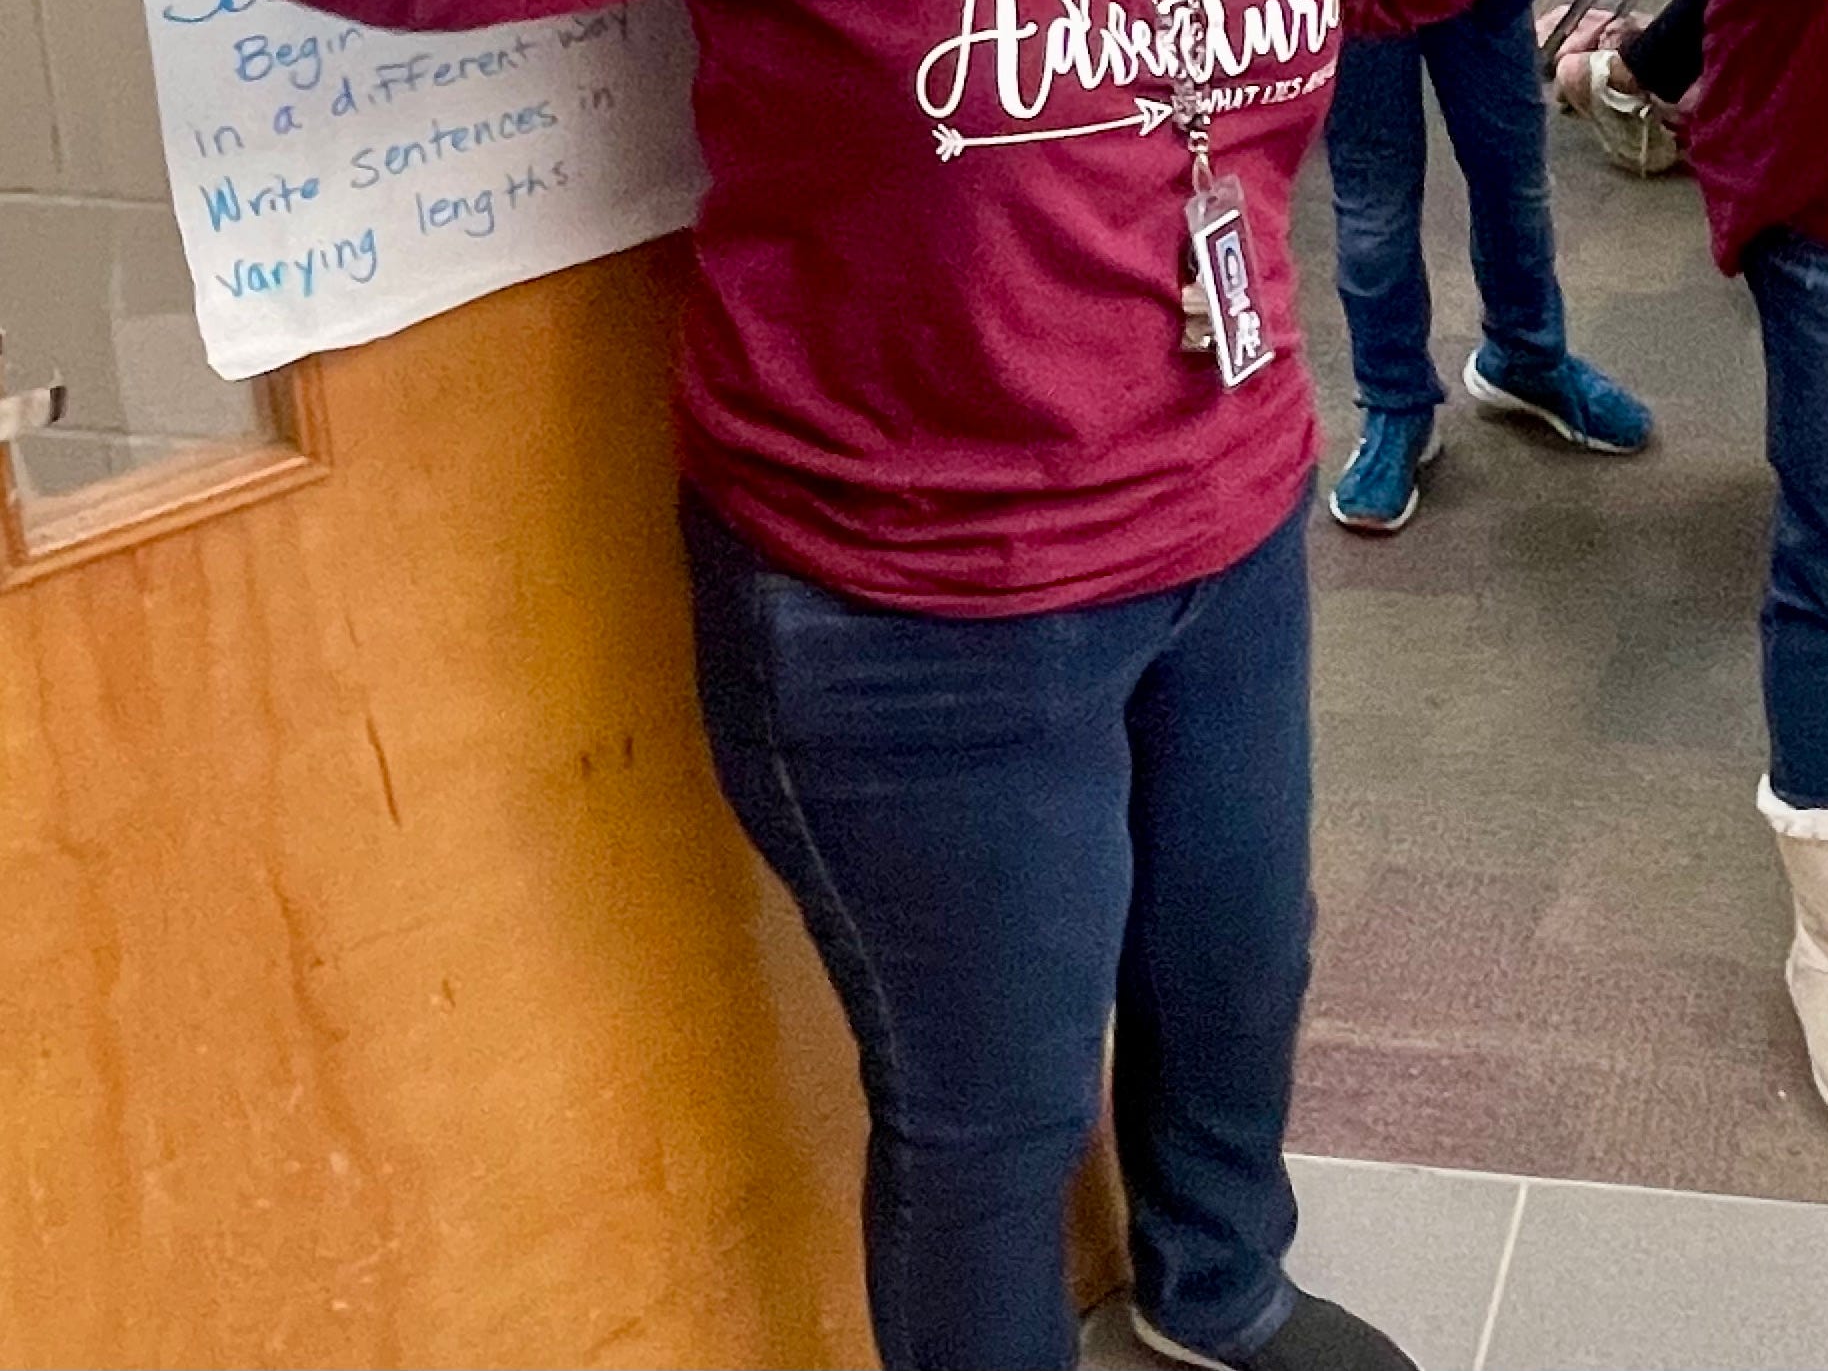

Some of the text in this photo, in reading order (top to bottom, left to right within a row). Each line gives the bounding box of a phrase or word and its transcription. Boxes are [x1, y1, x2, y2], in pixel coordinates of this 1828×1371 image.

[233, 27, 364, 91] Begin
[272, 104, 304, 136] a
[331, 34, 539, 118] different
[558, 7, 630, 49] way
[198, 173, 321, 233] Write
[577, 84, 616, 111] in
[415, 160, 570, 238] lengths
